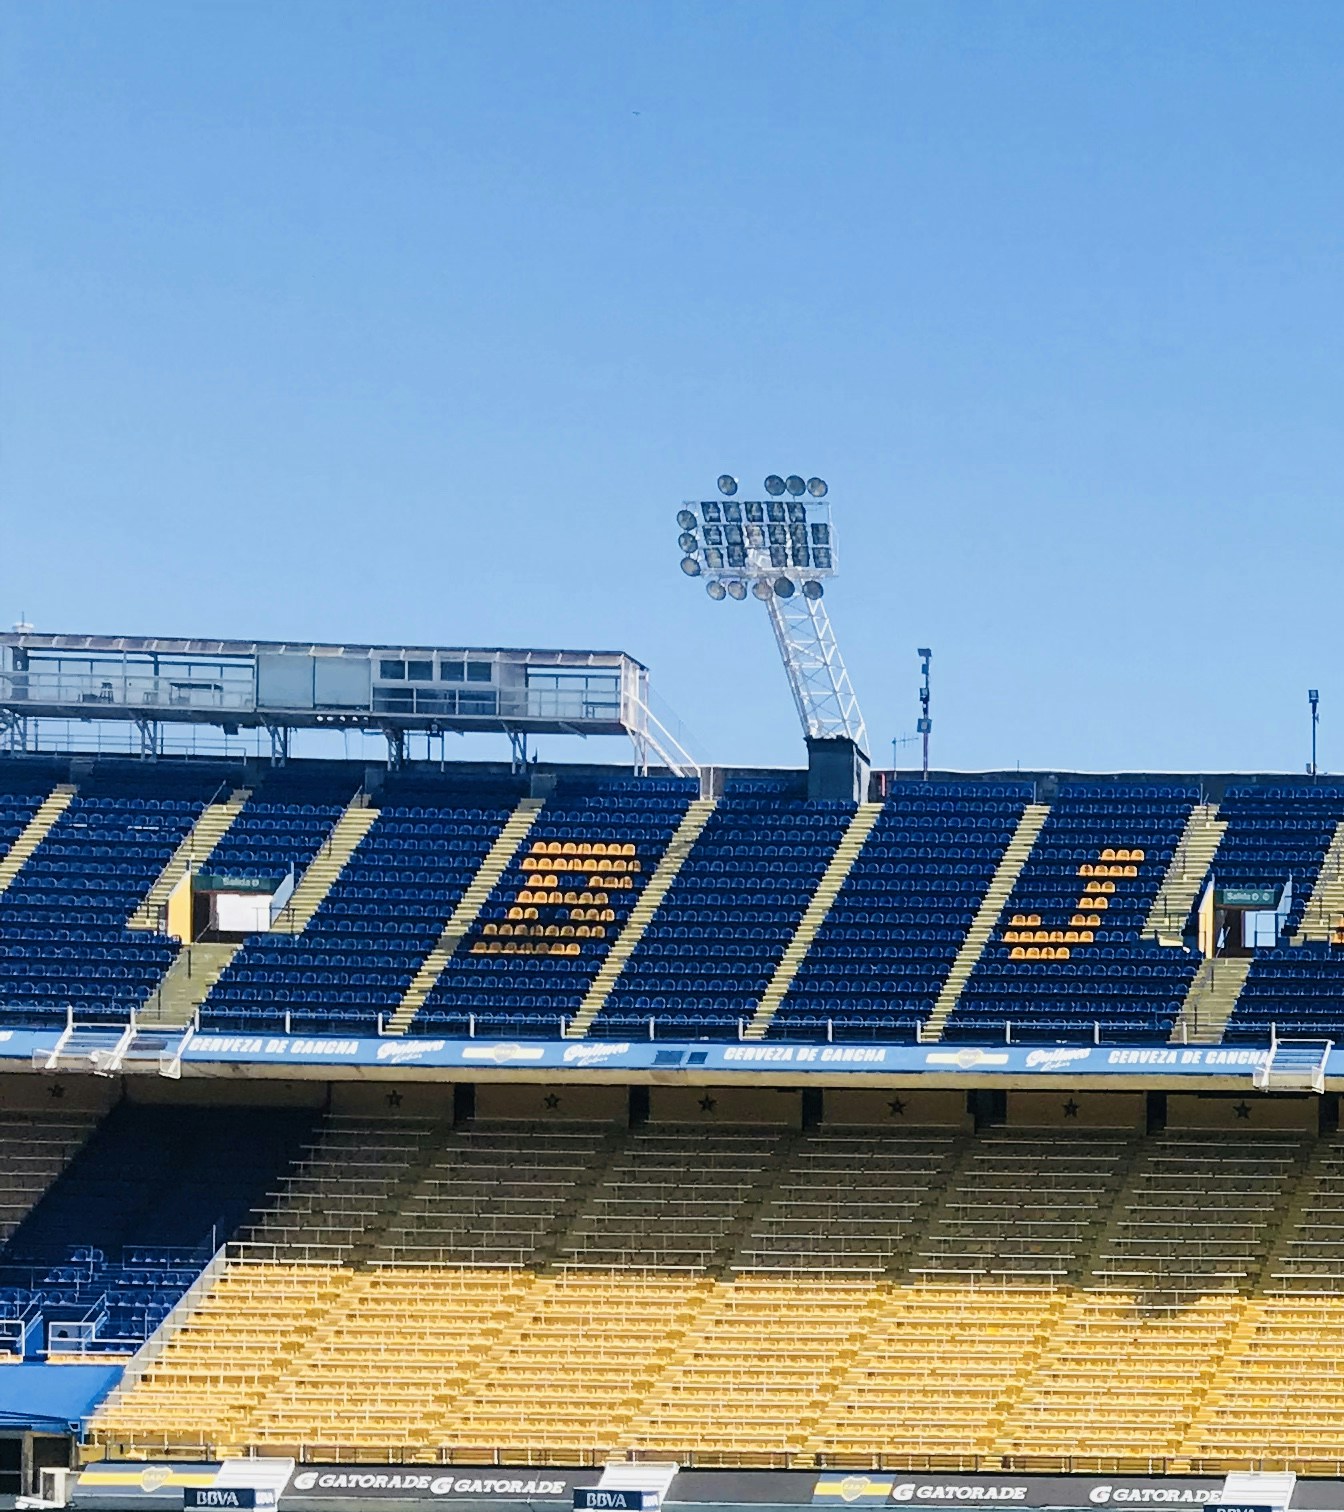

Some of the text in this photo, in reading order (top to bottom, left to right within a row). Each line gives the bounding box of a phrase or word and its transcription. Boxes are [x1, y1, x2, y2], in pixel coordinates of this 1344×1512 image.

[188, 1037, 359, 1055] CERVEZA DE CANCHA
[723, 1047, 887, 1062] CERVEZA DE CANCHA
[1180, 1049, 1201, 1065] DE
[319, 1474, 432, 1490] GATORADE
[454, 1479, 566, 1495] GATORADE
[197, 1491, 239, 1505] BBVA
[917, 1485, 1027, 1500] GATORADE
[1113, 1488, 1222, 1503] GATORADE
[587, 1493, 627, 1508] BBVA
